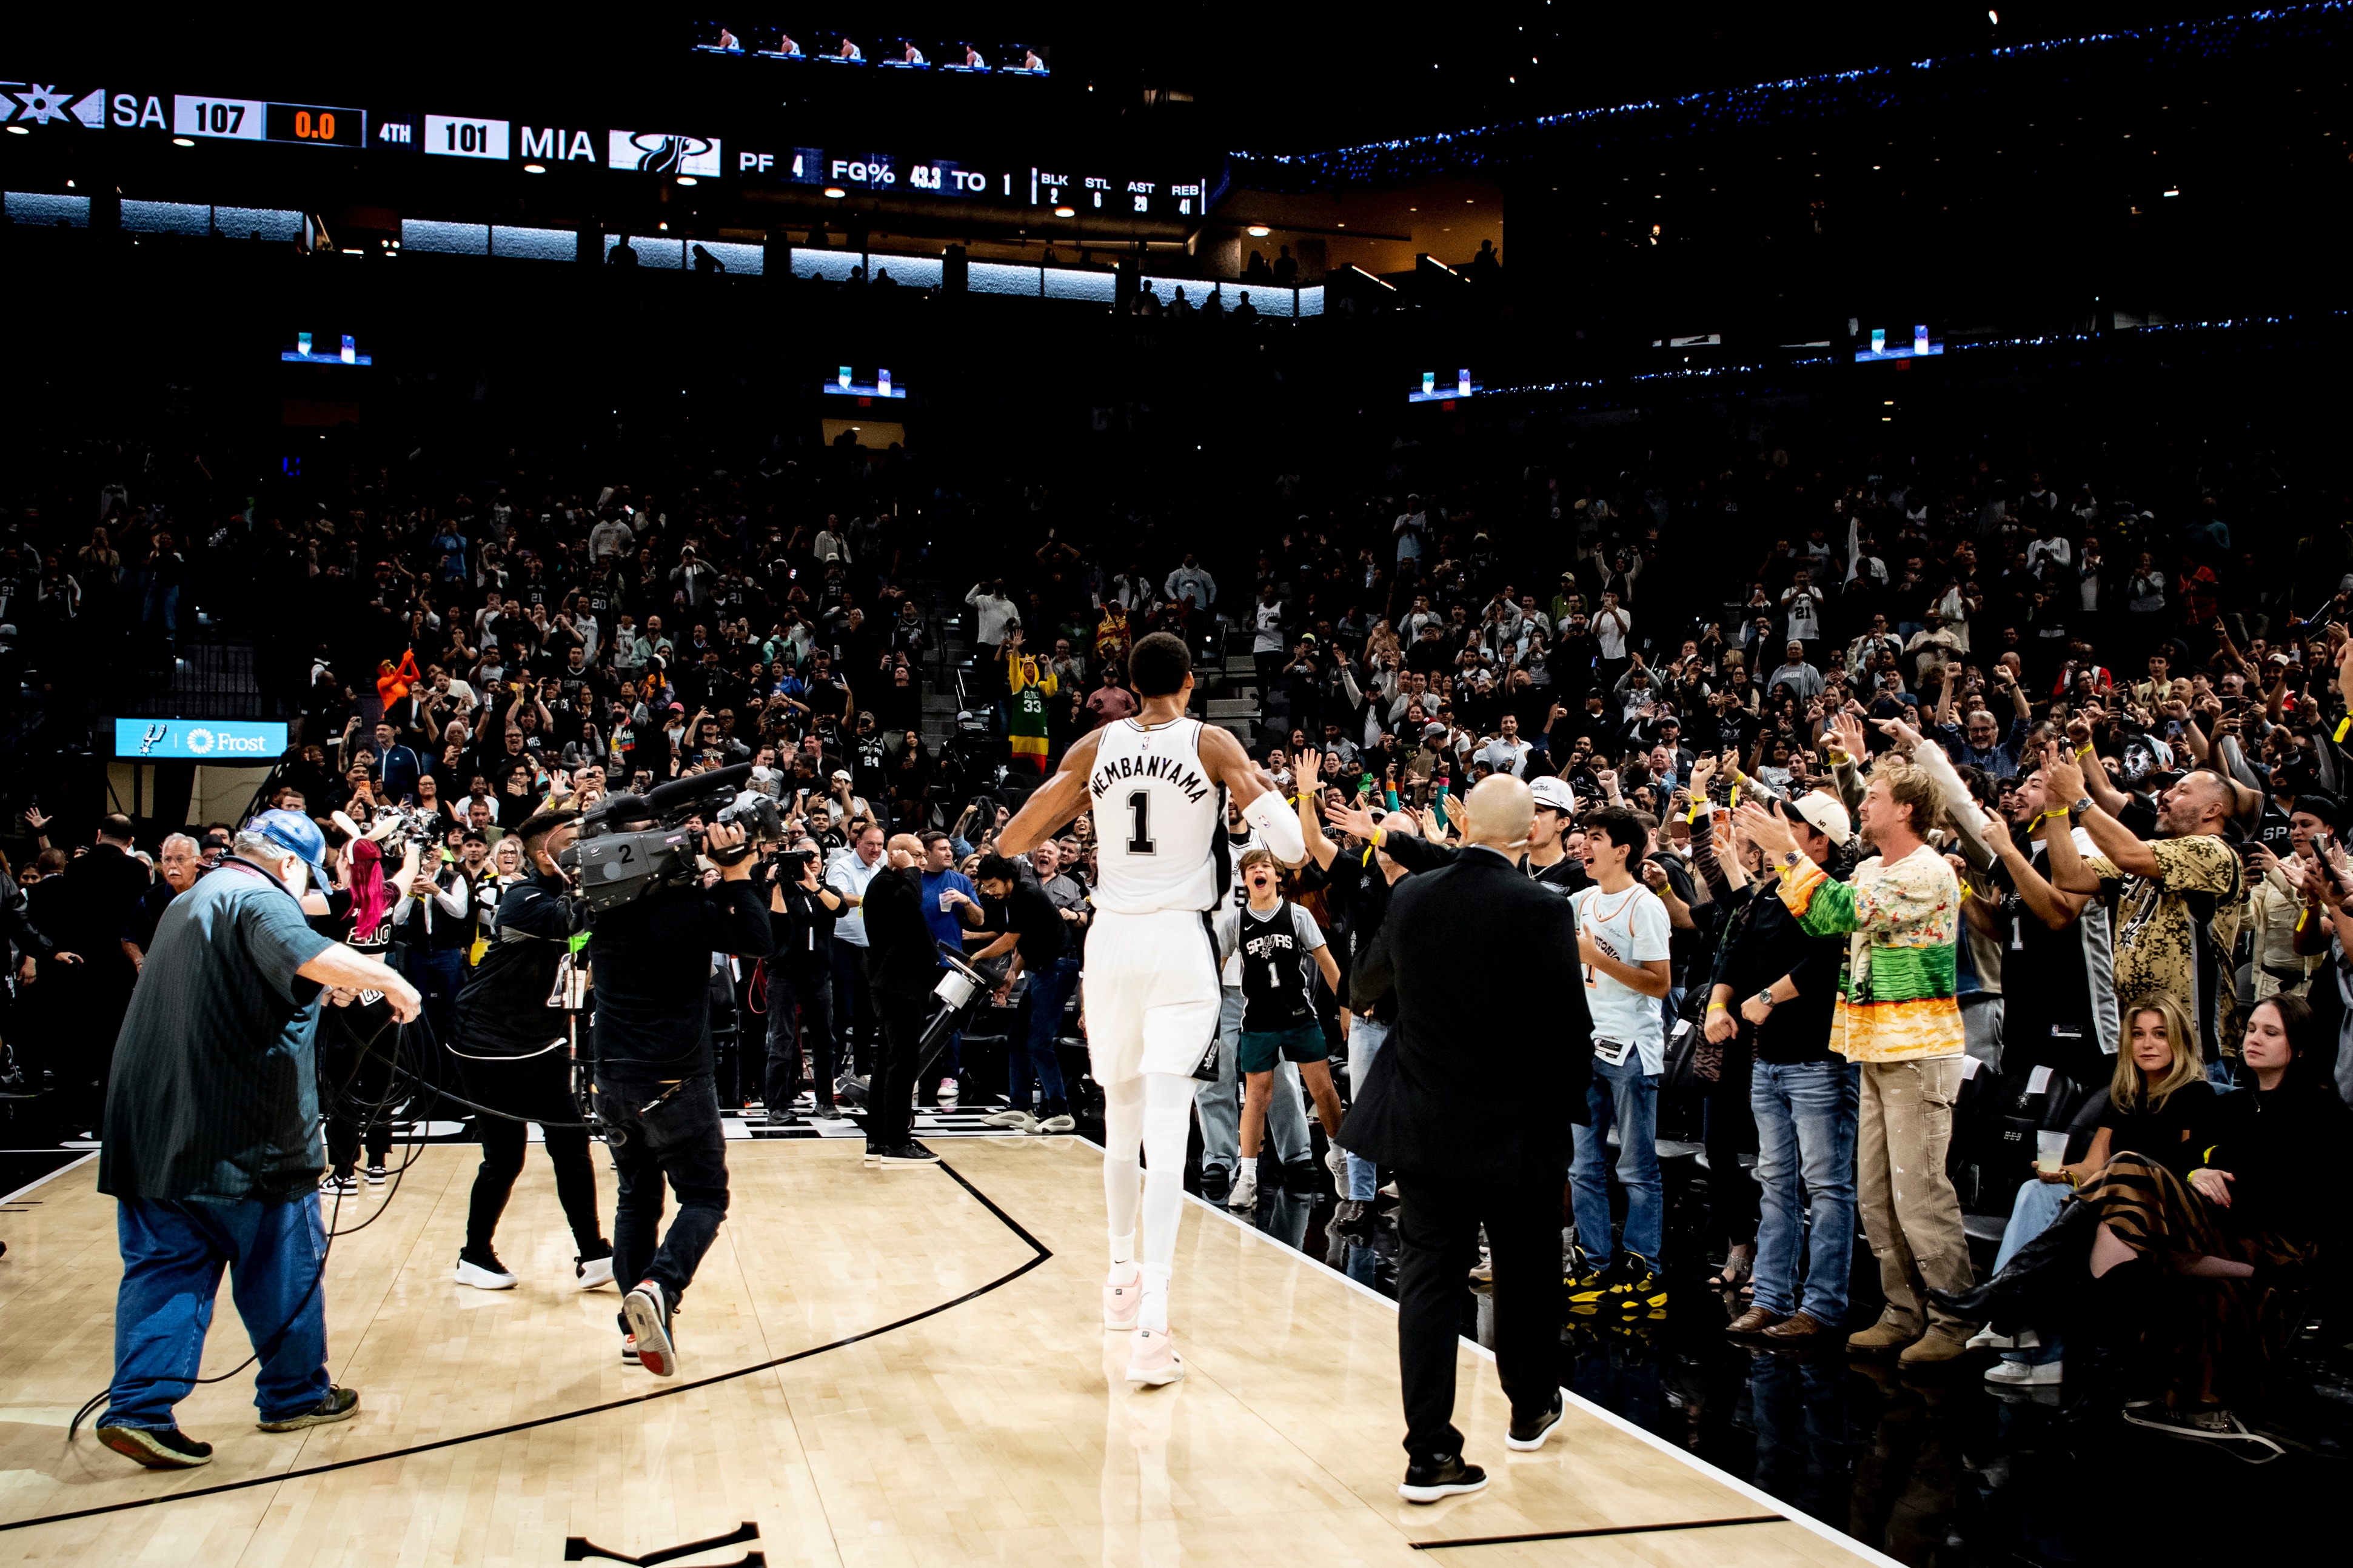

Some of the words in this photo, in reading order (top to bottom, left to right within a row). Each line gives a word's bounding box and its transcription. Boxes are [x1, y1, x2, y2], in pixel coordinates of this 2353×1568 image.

[113, 94, 166, 128] SA
[196, 102, 246, 134] 107
[295, 111, 335, 140] 0.0
[379, 123, 410, 142] 4TH
[446, 122, 487, 153] 101
[521, 126, 595, 162] MIA
[740, 152, 774, 172] PF
[792, 155, 803, 177] 4
[832, 160, 895, 183] FG%
[909, 165, 941, 189] 43.3
[951, 170, 986, 191] TO
[1003, 173, 1010, 195] 1
[1041, 173, 1068, 185] BLK
[1085, 177, 1111, 190] STL
[1127, 181, 1155, 193] AST
[1171, 185, 1199, 196] REB
[1050, 188, 1058, 204] 2
[1094, 192, 1102, 207] 6
[1134, 195, 1148, 212] 29
[1179, 199, 1190, 215] 41
[1896, 359, 1910, 371] EXIT
[858, 398, 872, 407] EXIT
[531, 592, 543, 602] 21
[591, 598, 607, 610] 20
[1795, 607, 1811, 619] 21
[708, 686, 714, 696] 1
[1464, 692, 1469, 702] 1
[1023, 699, 1042, 713] 33
[217, 733, 266, 752] Frost
[858, 746, 883, 756] SPURS
[863, 756, 879, 767] 24
[1091, 755, 1208, 804] WEMBANYAMA
[1126, 789, 1157, 856] 1
[618, 844, 635, 864] 2
[2010, 915, 2024, 950] 1
[1246, 933, 1293, 960] SPURS
[1267, 962, 1280, 989] 1
